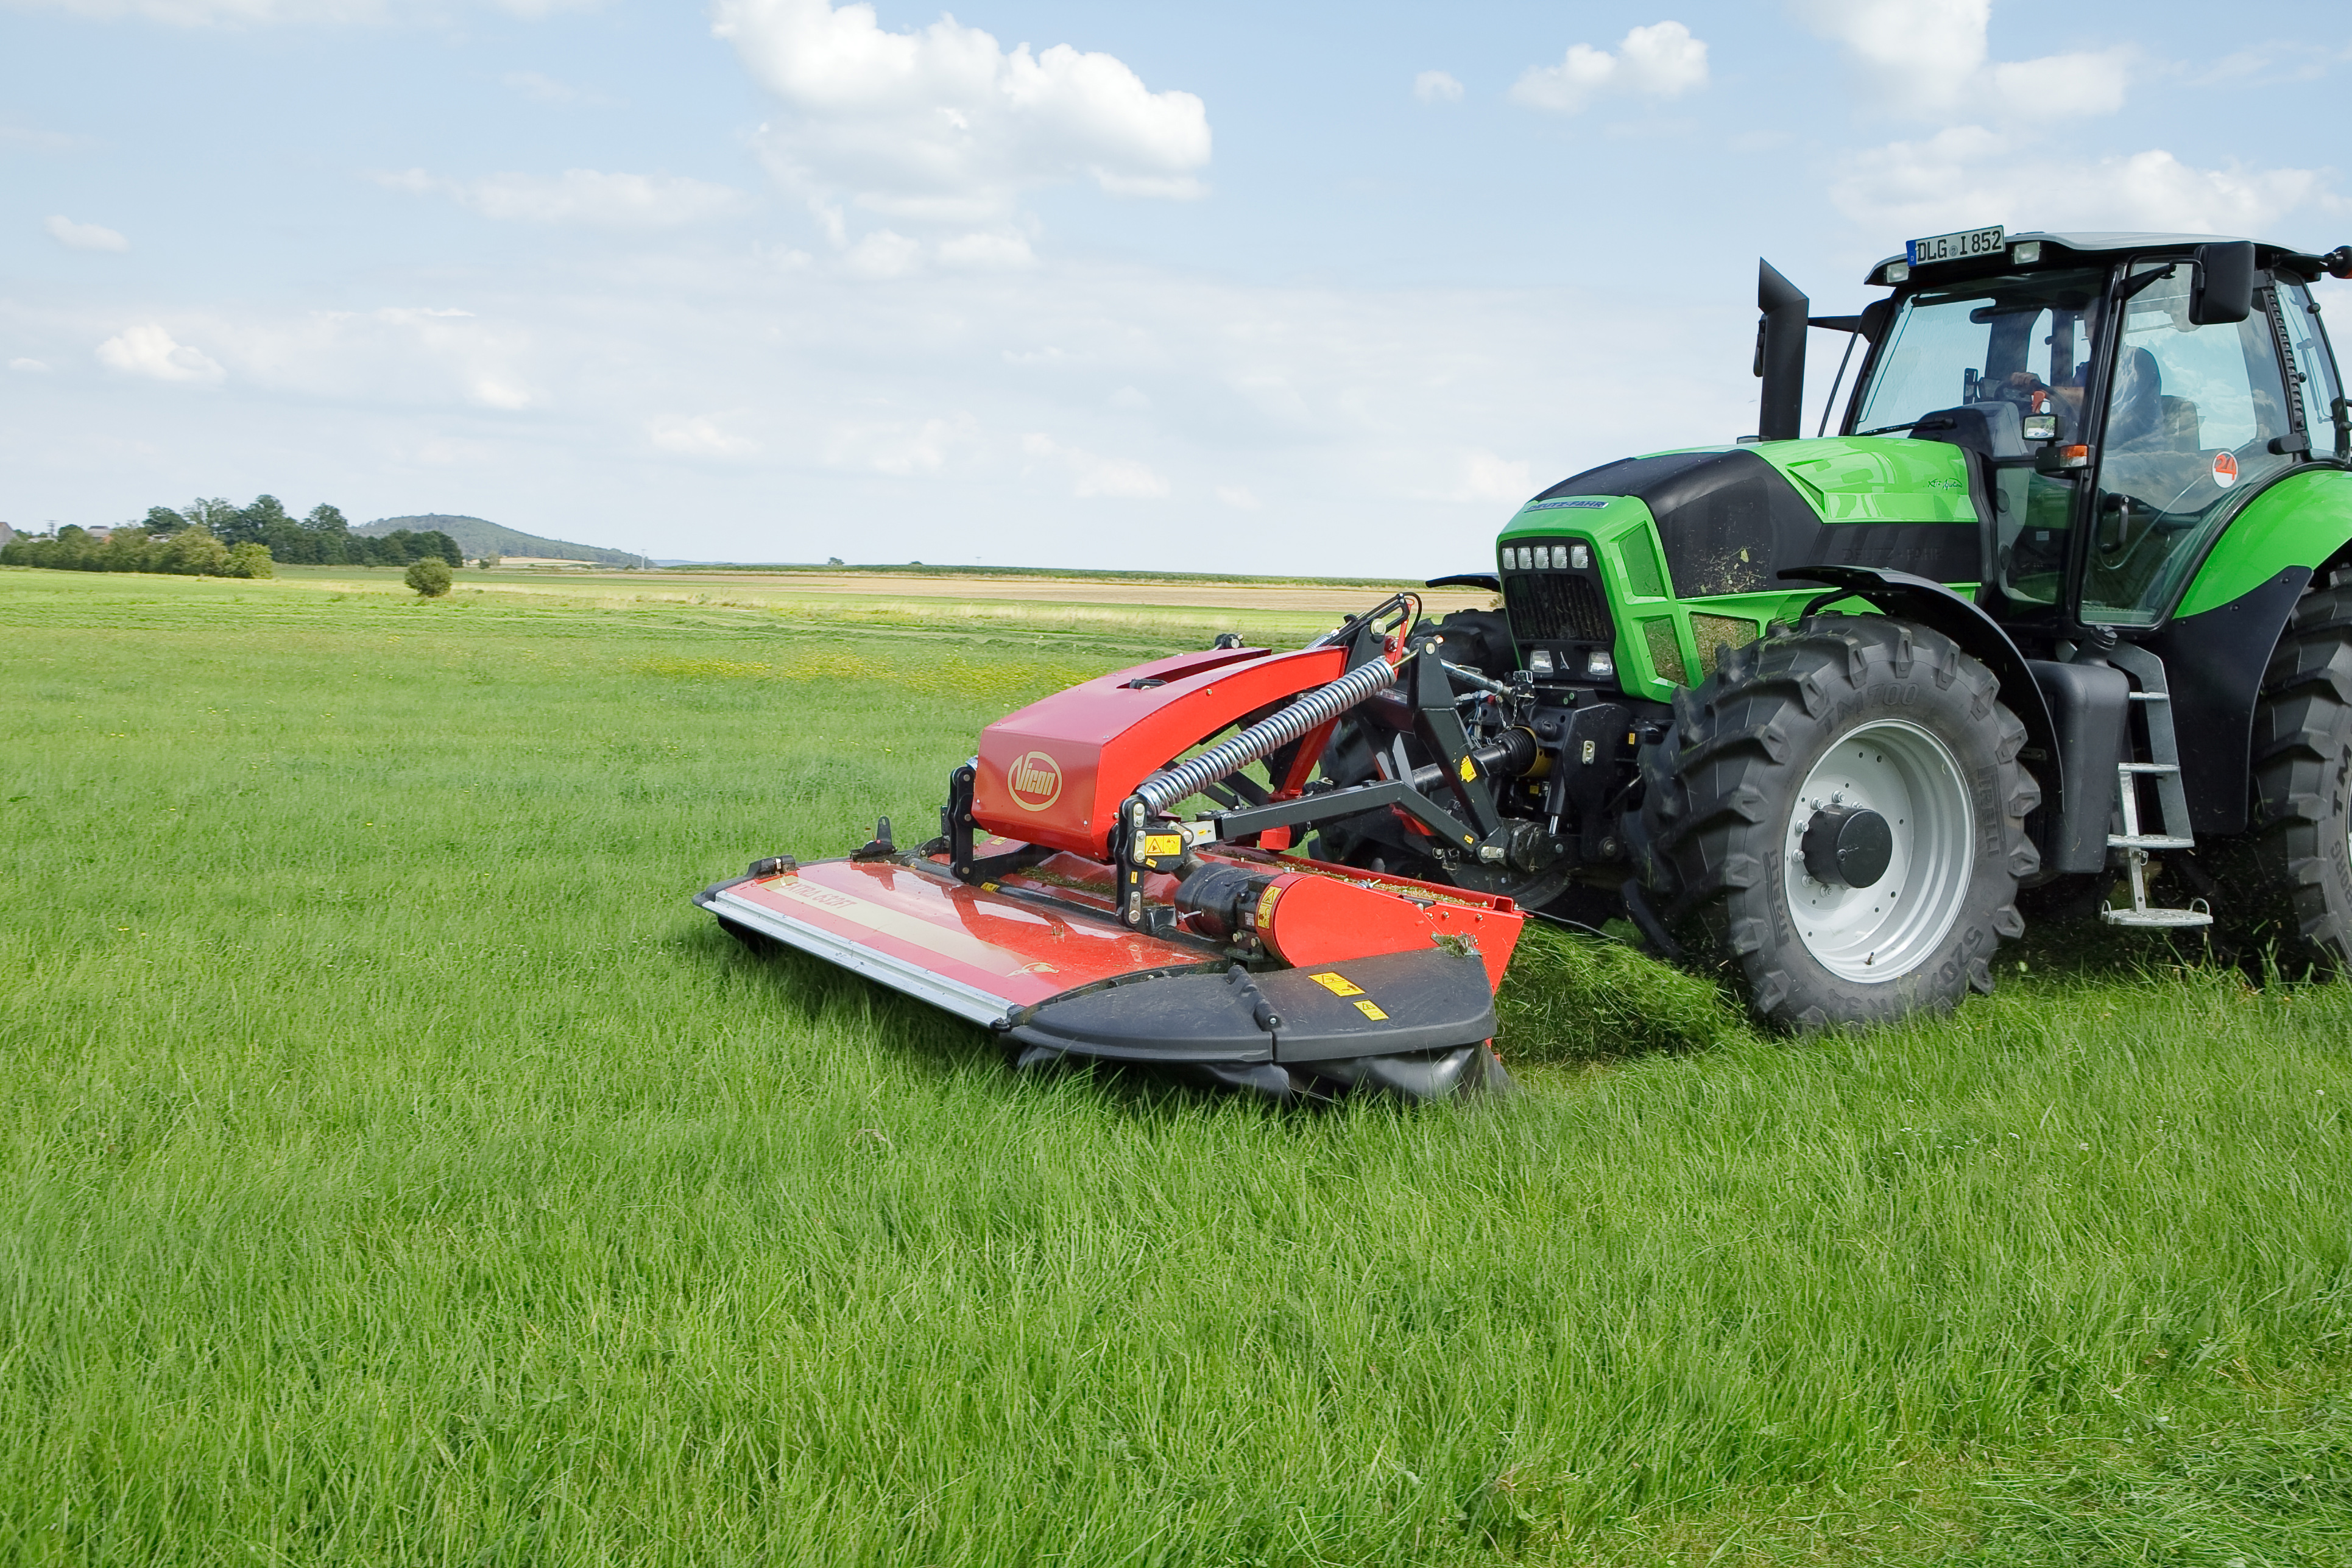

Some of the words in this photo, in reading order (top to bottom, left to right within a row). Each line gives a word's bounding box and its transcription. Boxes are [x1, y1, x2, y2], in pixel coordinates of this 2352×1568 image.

[1917, 239, 1947, 261] DLG
[1960, 236, 1968, 255] I
[1971, 230, 2002, 253] 852
[2215, 454, 2237, 481] 24
[1527, 501, 1604, 510] DEUTZ-FAHR
[1012, 752, 1057, 796] Vicon
[1977, 763, 2007, 859] PIRELLI
[781, 881, 823, 898] EXTRA
[812, 893, 858, 909] 632FT
